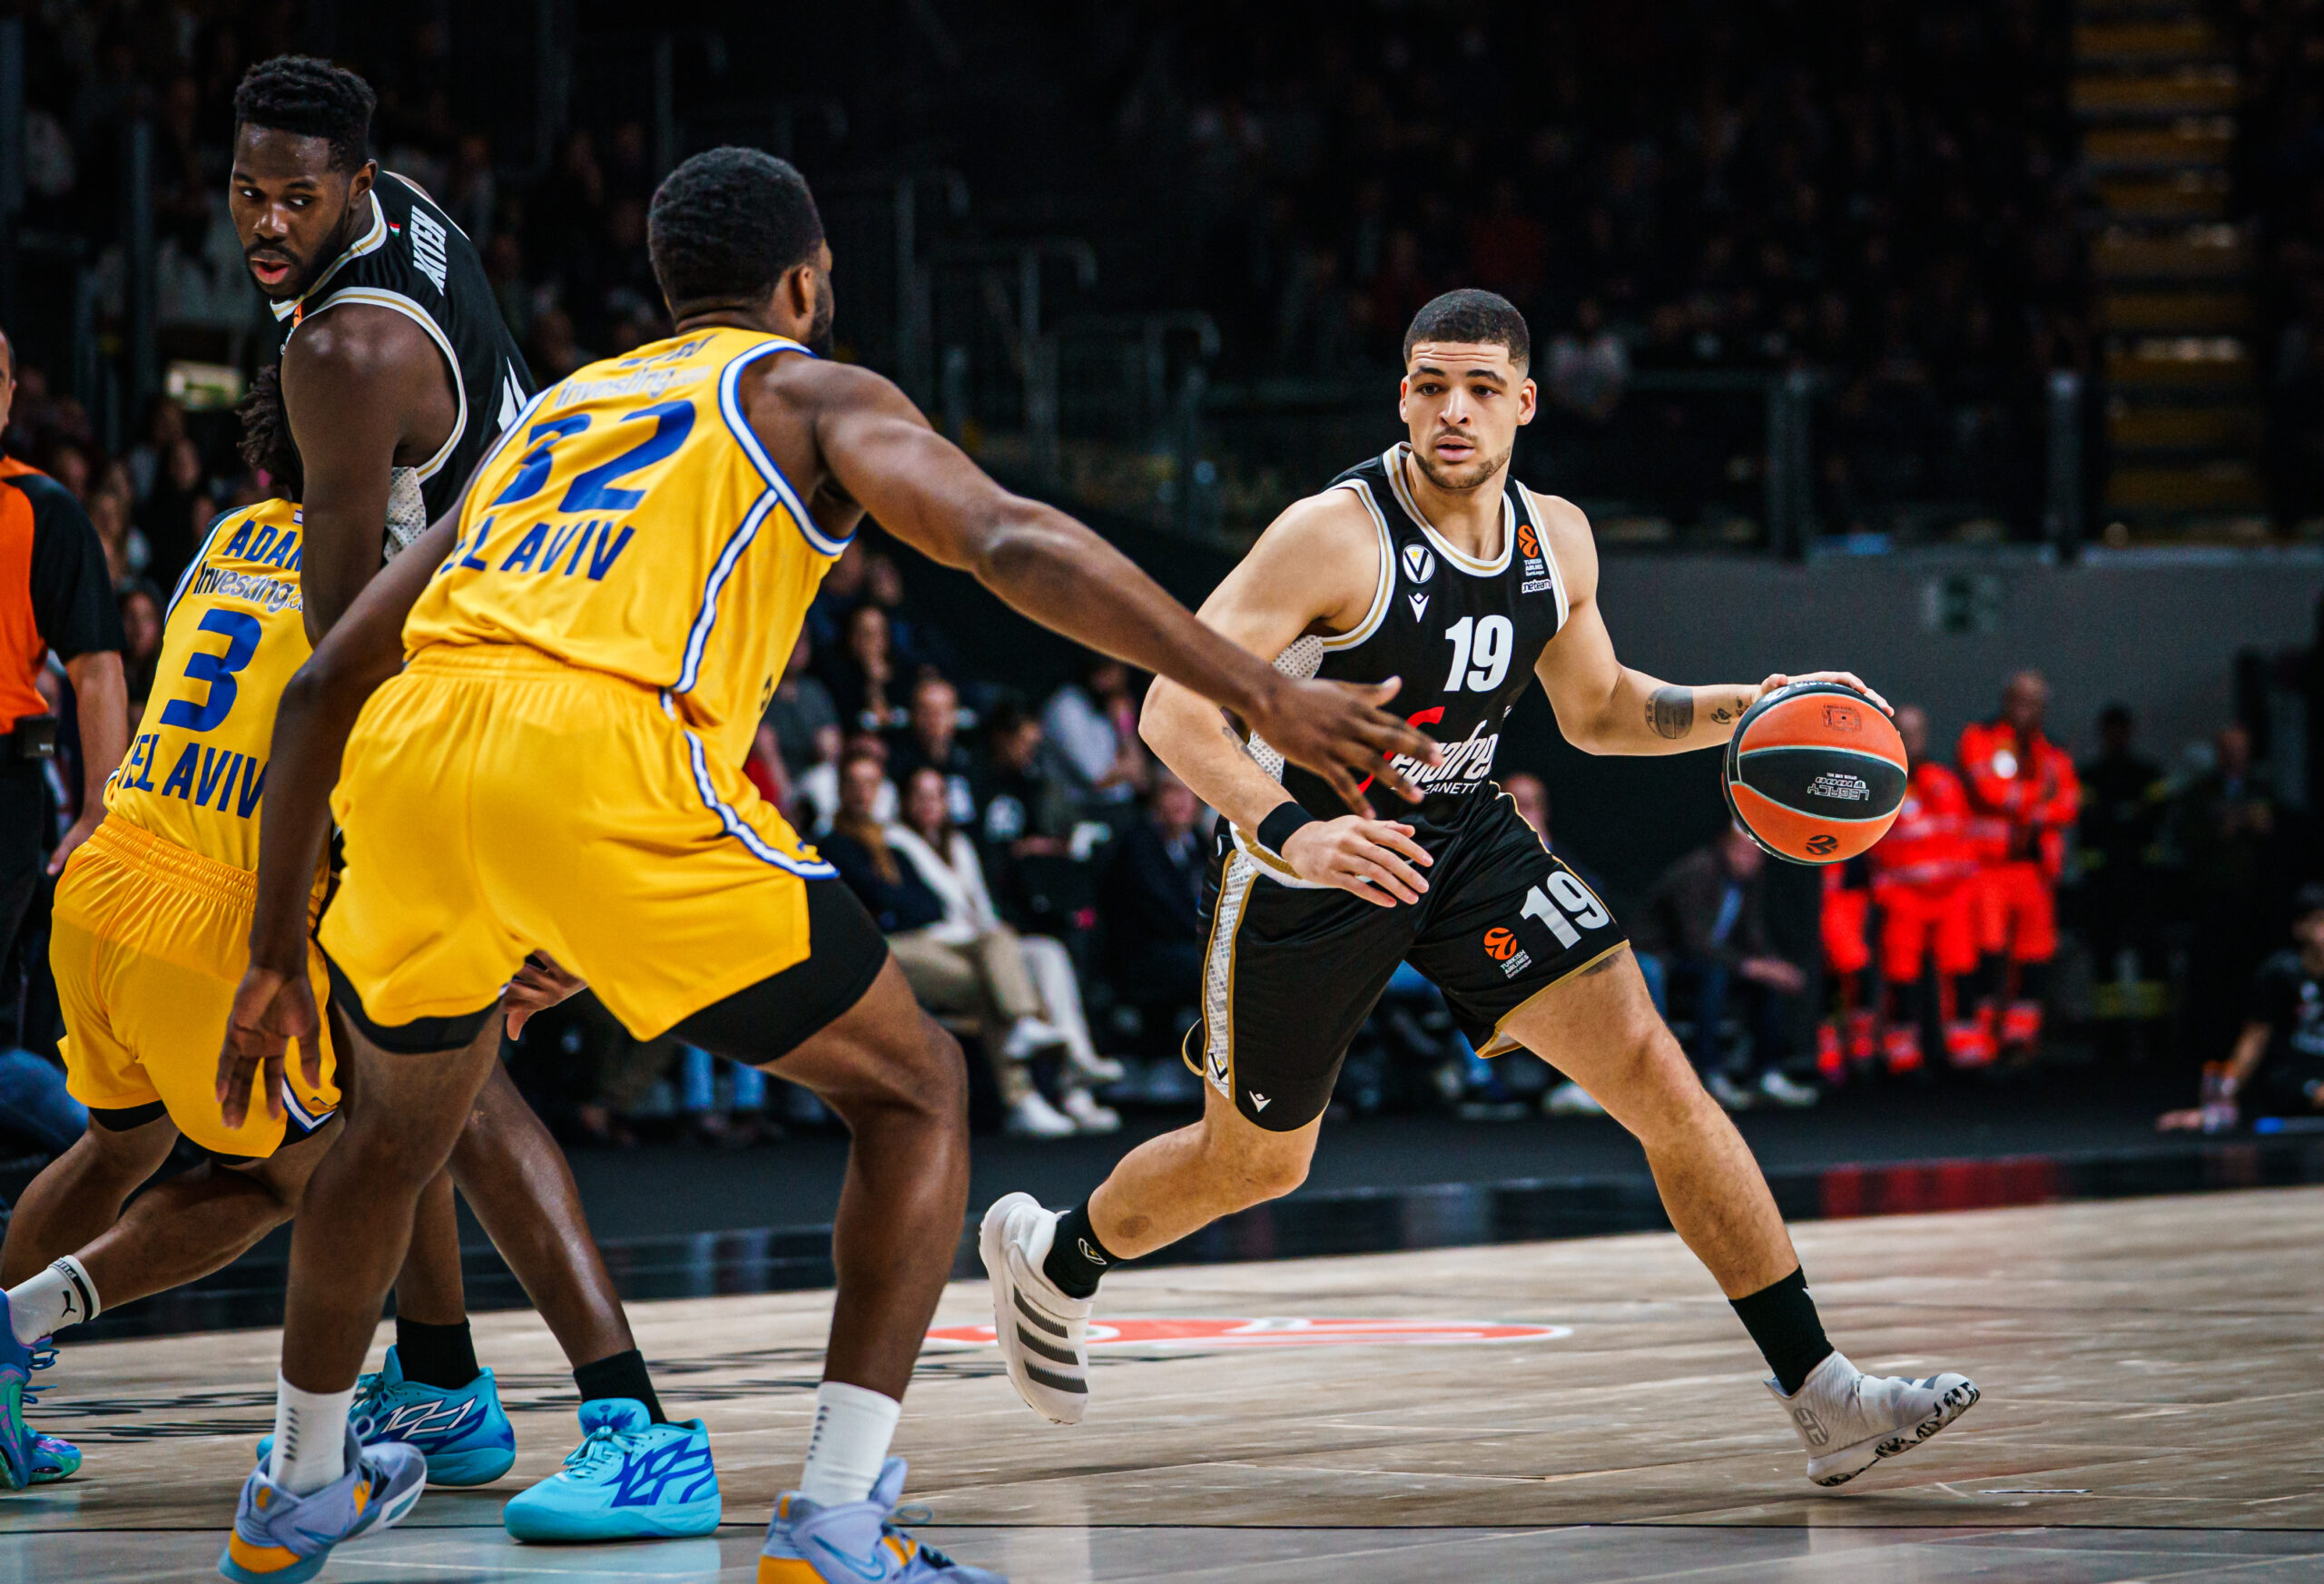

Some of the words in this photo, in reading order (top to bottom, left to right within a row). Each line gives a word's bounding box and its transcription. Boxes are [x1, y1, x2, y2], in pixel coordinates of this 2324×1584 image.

[491, 399, 696, 515] 32
[500, 520, 635, 582] AVIV
[159, 607, 262, 733] 3
[1443, 615, 1513, 693] 19
[118, 733, 161, 792] EL
[162, 742, 270, 819] AVIV
[1423, 781, 1482, 795] ZANETT
[1807, 782, 1870, 801] LEGACY
[1519, 871, 1610, 949] 19
